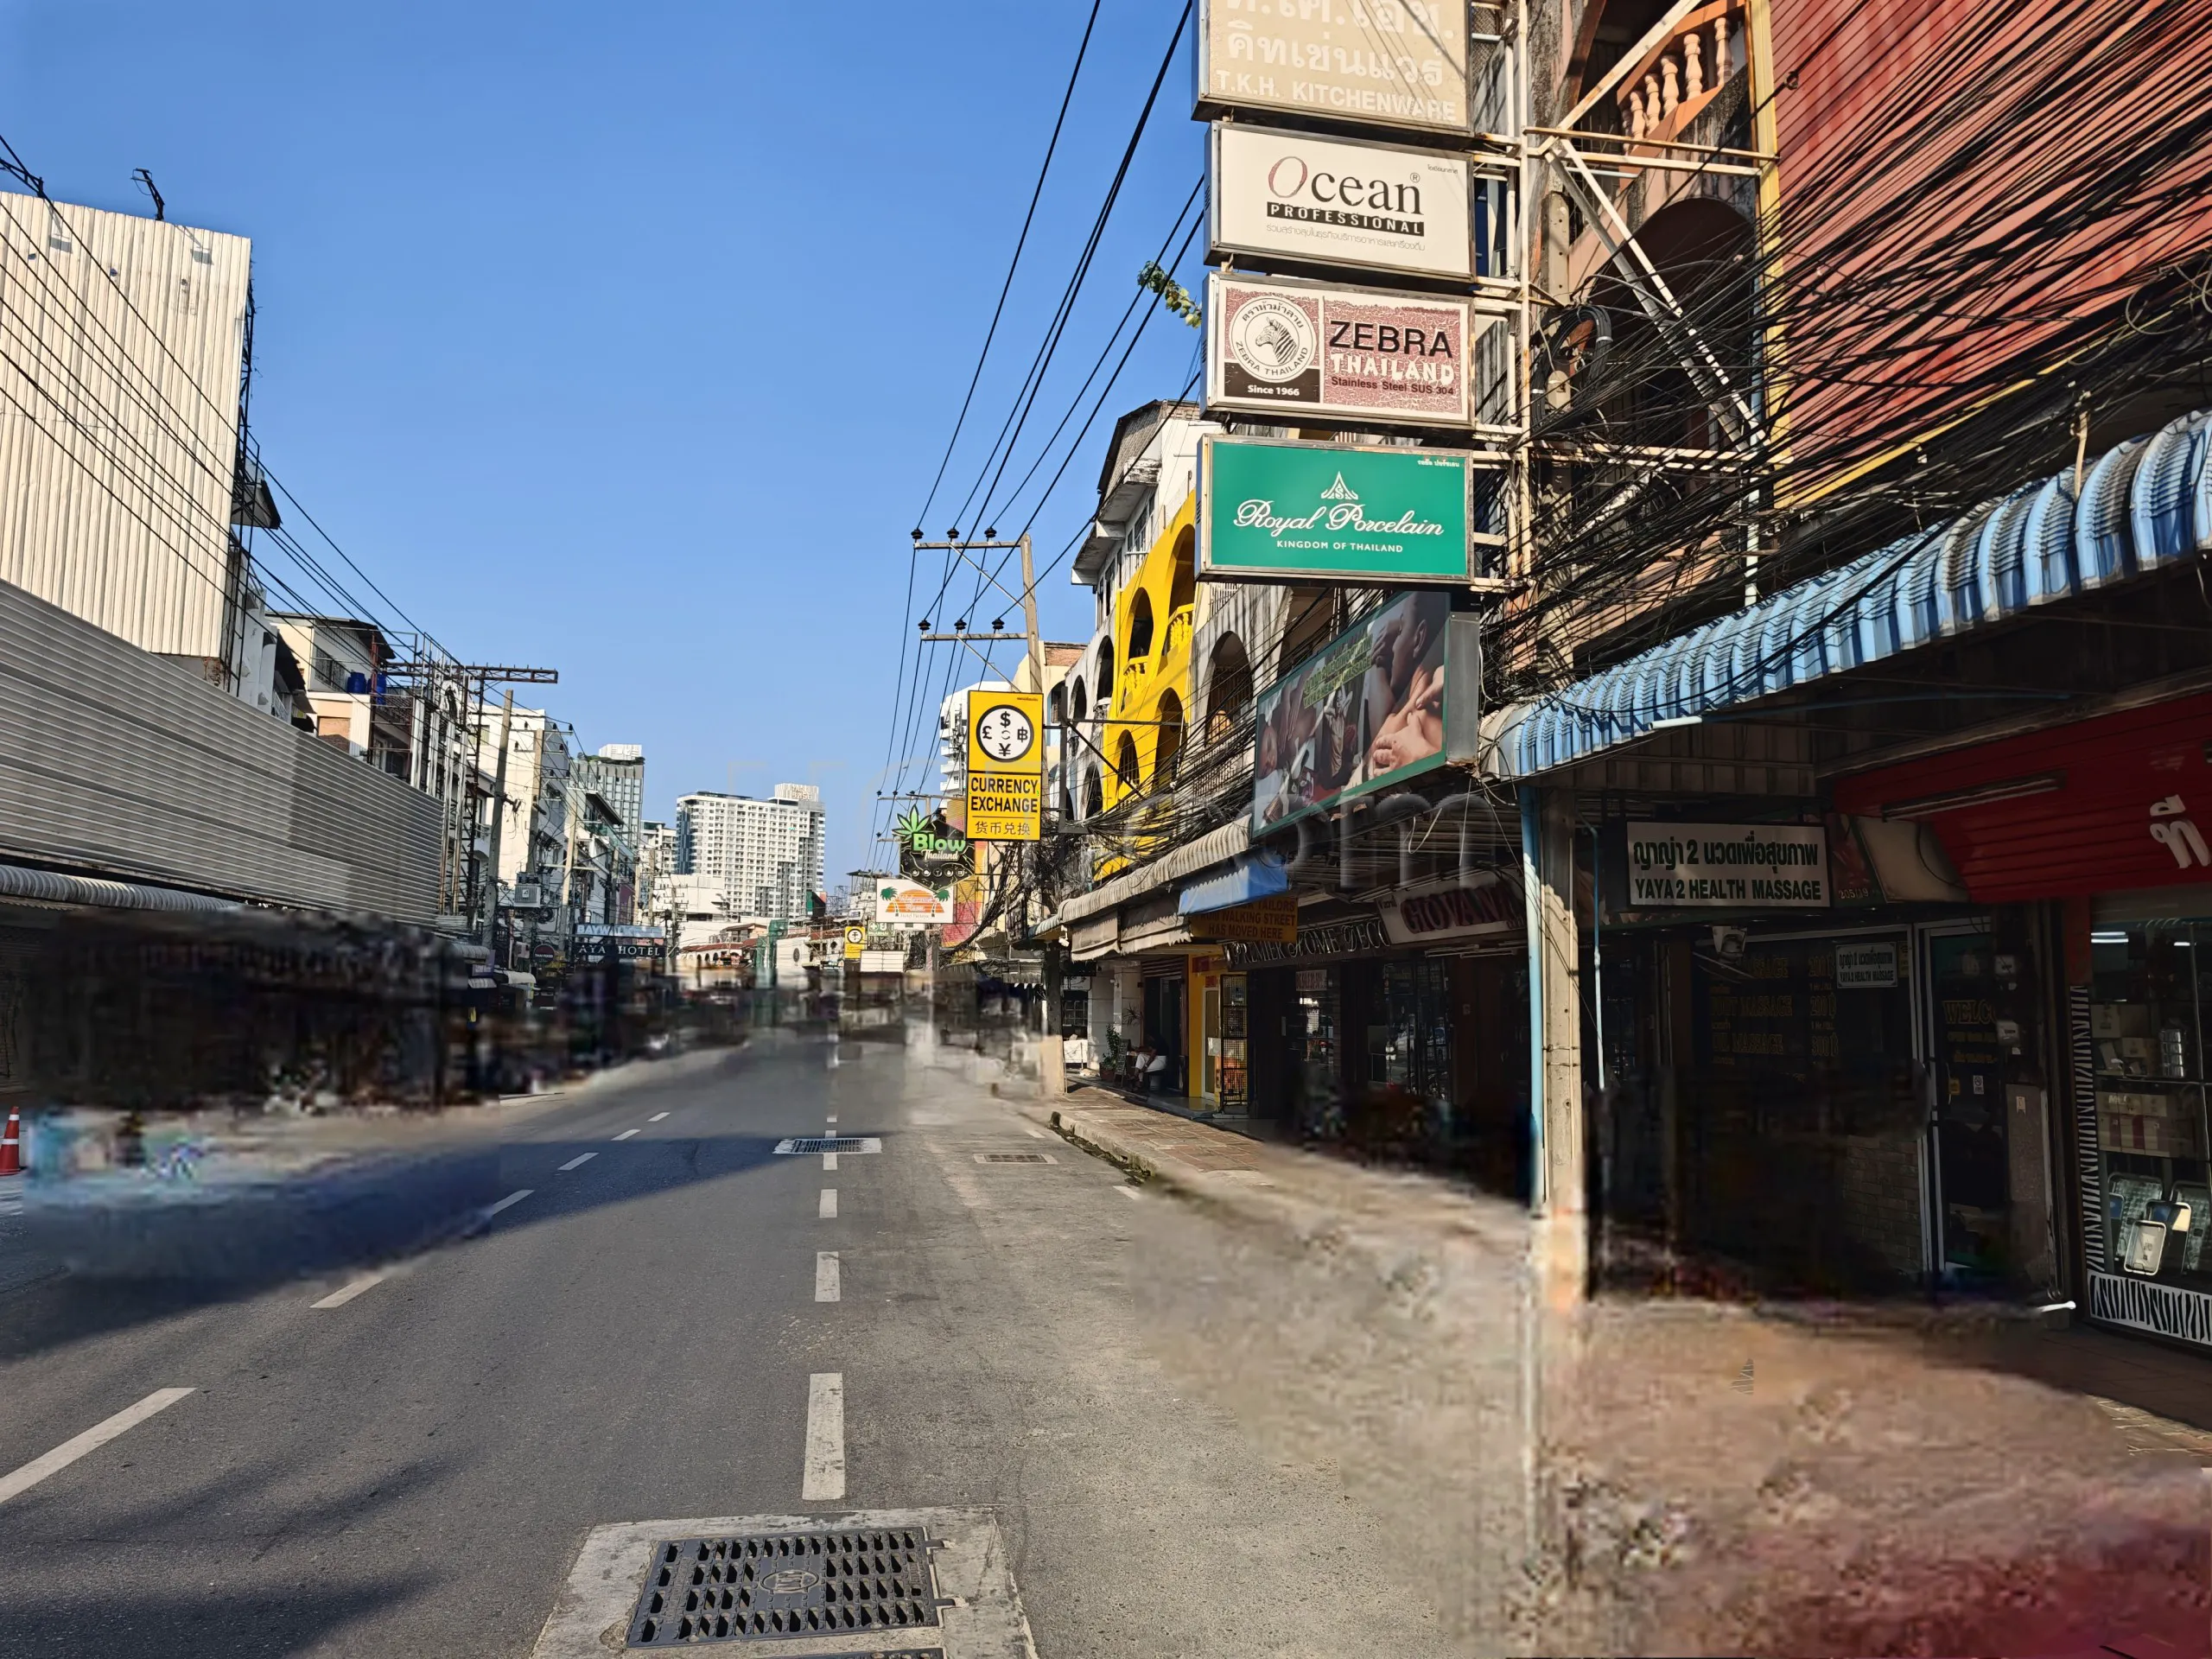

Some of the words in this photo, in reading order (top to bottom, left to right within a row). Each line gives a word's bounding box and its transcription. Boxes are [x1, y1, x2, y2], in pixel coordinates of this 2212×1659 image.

[1217, 70, 1280, 99] T.K.H.
[1293, 81, 1458, 121] KITCHENWARE
[1268, 156, 1424, 216] Ocean
[1270, 203, 1422, 236] PROFESSIONAL
[1329, 320, 1453, 358] ZEBRA
[1236, 340, 1261, 372] ZEBRA
[1264, 346, 1308, 376] THAILAND
[1330, 353, 1455, 386] THAILAND
[1247, 384, 1274, 394] Since
[1276, 386, 1300, 397] 1966
[1332, 377, 1377, 390] Stainless
[1382, 380, 1407, 392] Steel
[1411, 383, 1433, 394] SUS
[1435, 385, 1454, 396] 304
[1233, 499, 1327, 537] Royal
[1325, 503, 1445, 536] Porcelain
[1276, 540, 1329, 550] KINGDOM
[1332, 541, 1347, 550] OF
[1351, 543, 1403, 553] THAILAND
[970, 777, 1039, 794] CURRENCY
[970, 796, 1038, 813] EXCHANGE
[975, 820, 1031, 836] 货币兑换
[912, 833, 966, 851] Blow
[921, 849, 959, 861] Thailand
[1633, 836, 1684, 871] ญาญ่า
[1687, 839, 1699, 865] 2
[1704, 830, 1819, 874] นวดเพื่อสุขภาพ
[1635, 879, 1673, 899] YAYA
[1689, 879, 1746, 899] HEALTH
[1752, 880, 1821, 900] MASSAGE
[1222, 910, 1262, 925] WALKING
[1263, 912, 1296, 926] STREET
[1228, 924, 1258, 938] MOVED
[1260, 926, 1283, 939] HERE
[618, 945, 660, 956] HOTEL
